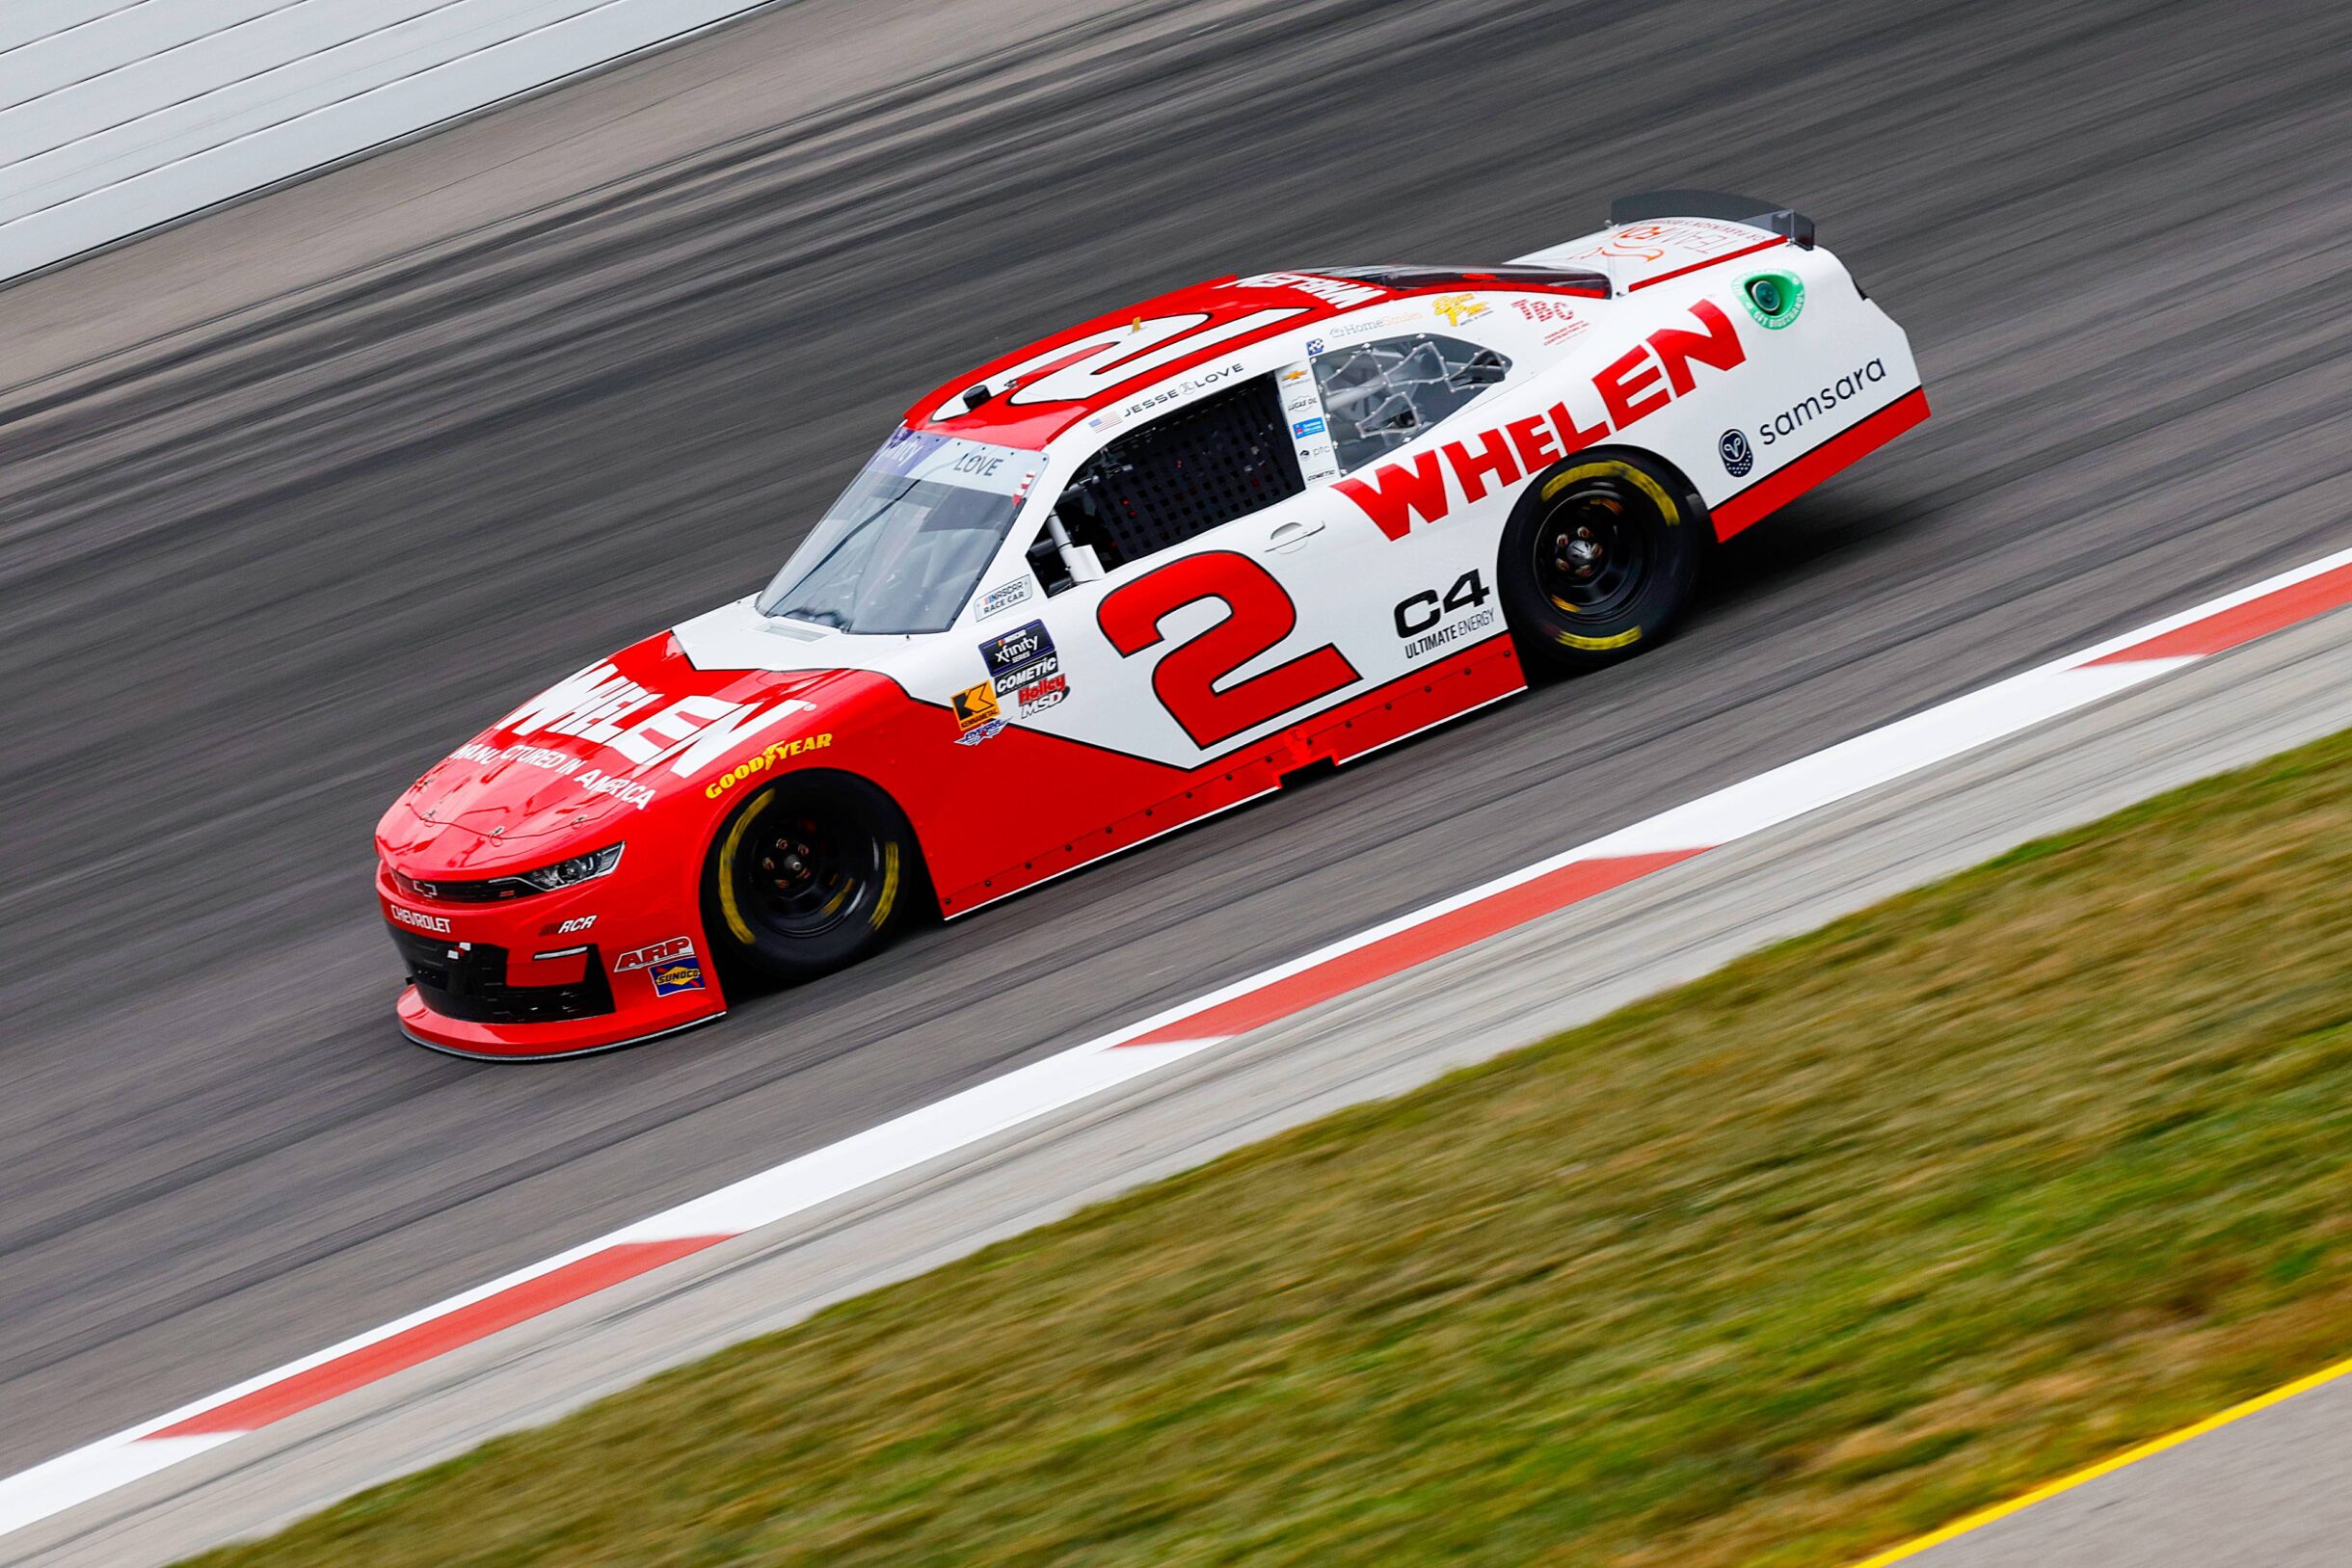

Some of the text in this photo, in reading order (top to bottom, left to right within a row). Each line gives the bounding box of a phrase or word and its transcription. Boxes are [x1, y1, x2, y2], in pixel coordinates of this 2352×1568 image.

[931, 306, 1314, 423] 2
[1124, 389, 1179, 417] JESSE
[1194, 363, 1244, 388] LOVE
[1759, 358, 1886, 445] samsara
[1330, 298, 1748, 542] WHELEN
[953, 453, 1004, 477] LOVE
[983, 591, 1026, 615] RACE CAR
[1394, 568, 1490, 639] C4
[995, 636, 1039, 662] xfinity
[1097, 549, 1365, 752] 2
[1404, 607, 1495, 659] ULTIMATE ENERGY
[996, 657, 1056, 693] COMETIC
[1018, 674, 1066, 706] Holley
[1021, 692, 1064, 719] MSD
[705, 732, 833, 800] GOODYEAR
[555, 758, 586, 776] IN
[574, 769, 656, 811] AMERICA
[390, 904, 451, 934] CHEVROLET
[558, 915, 598, 934] RCR
[615, 937, 690, 970] ARP
[657, 968, 701, 985] SUNOCO
